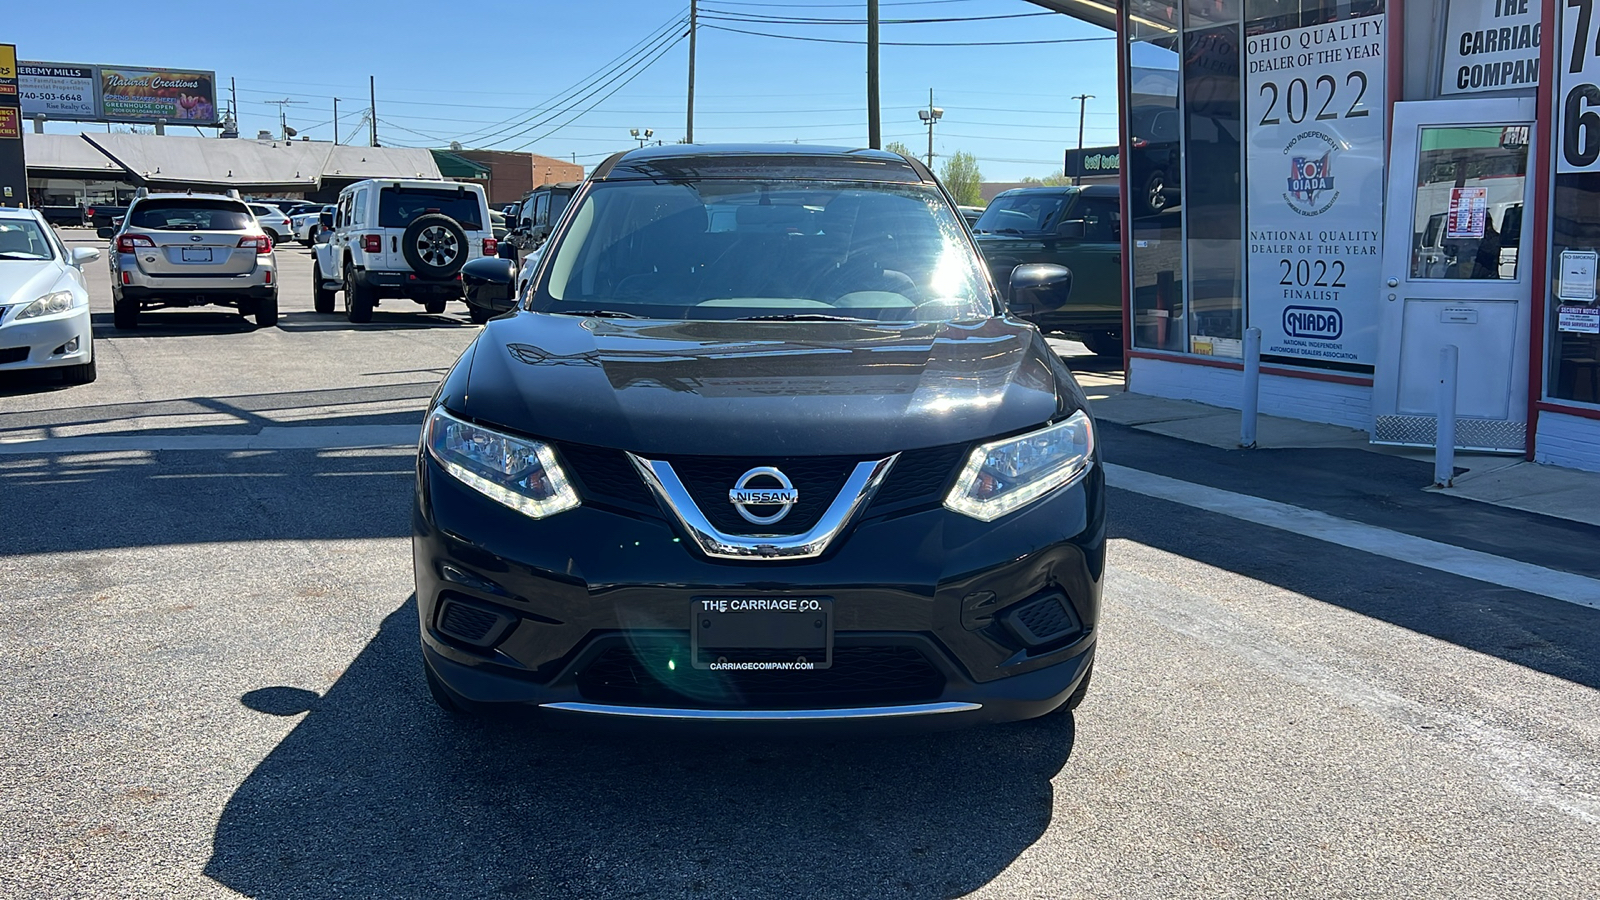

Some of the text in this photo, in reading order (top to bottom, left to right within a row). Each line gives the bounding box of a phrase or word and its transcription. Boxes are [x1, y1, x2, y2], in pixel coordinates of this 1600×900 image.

[1494, 0, 1528, 18] THE
[1248, 19, 1383, 55] OHIO QUALITY
[1459, 22, 1541, 56] CARRIAG
[1567, 0, 1600, 73] 7
[1250, 55, 1295, 74] DEALER
[1297, 52, 1314, 67] OF
[1316, 48, 1342, 64] THE
[1345, 42, 1381, 60] YEAR
[54, 68, 81, 77] MILLS
[1457, 58, 1540, 90] COMPAN
[107, 75, 199, 89] Natural Creations
[20, 92, 82, 101] 740-503-6648
[1259, 70, 1369, 126] 2022
[60, 103, 79, 111] Realty
[1283, 131, 1340, 155] OHIO INDEPENDENT
[1293, 178, 1327, 191] OIADA
[1301, 209, 1319, 217] DEALERS
[1250, 231, 1379, 242] NATIONAL QUALITY
[1251, 244, 1377, 255] DEALER OF THE YEAR
[1279, 258, 1346, 288] 2022
[1283, 289, 1340, 301] FINALIST
[1287, 312, 1337, 334] NIADA
[1283, 339, 1343, 350] NATIONAL INDEPENDENT
[1270, 346, 1358, 360] AUTOMOBILE DEALERS ASSOCIATION
[736, 492, 791, 501] NISSAN
[702, 600, 822, 611] THE CARRIAGE CO.
[709, 662, 814, 671] CARRIAGECOMPANY.COM
